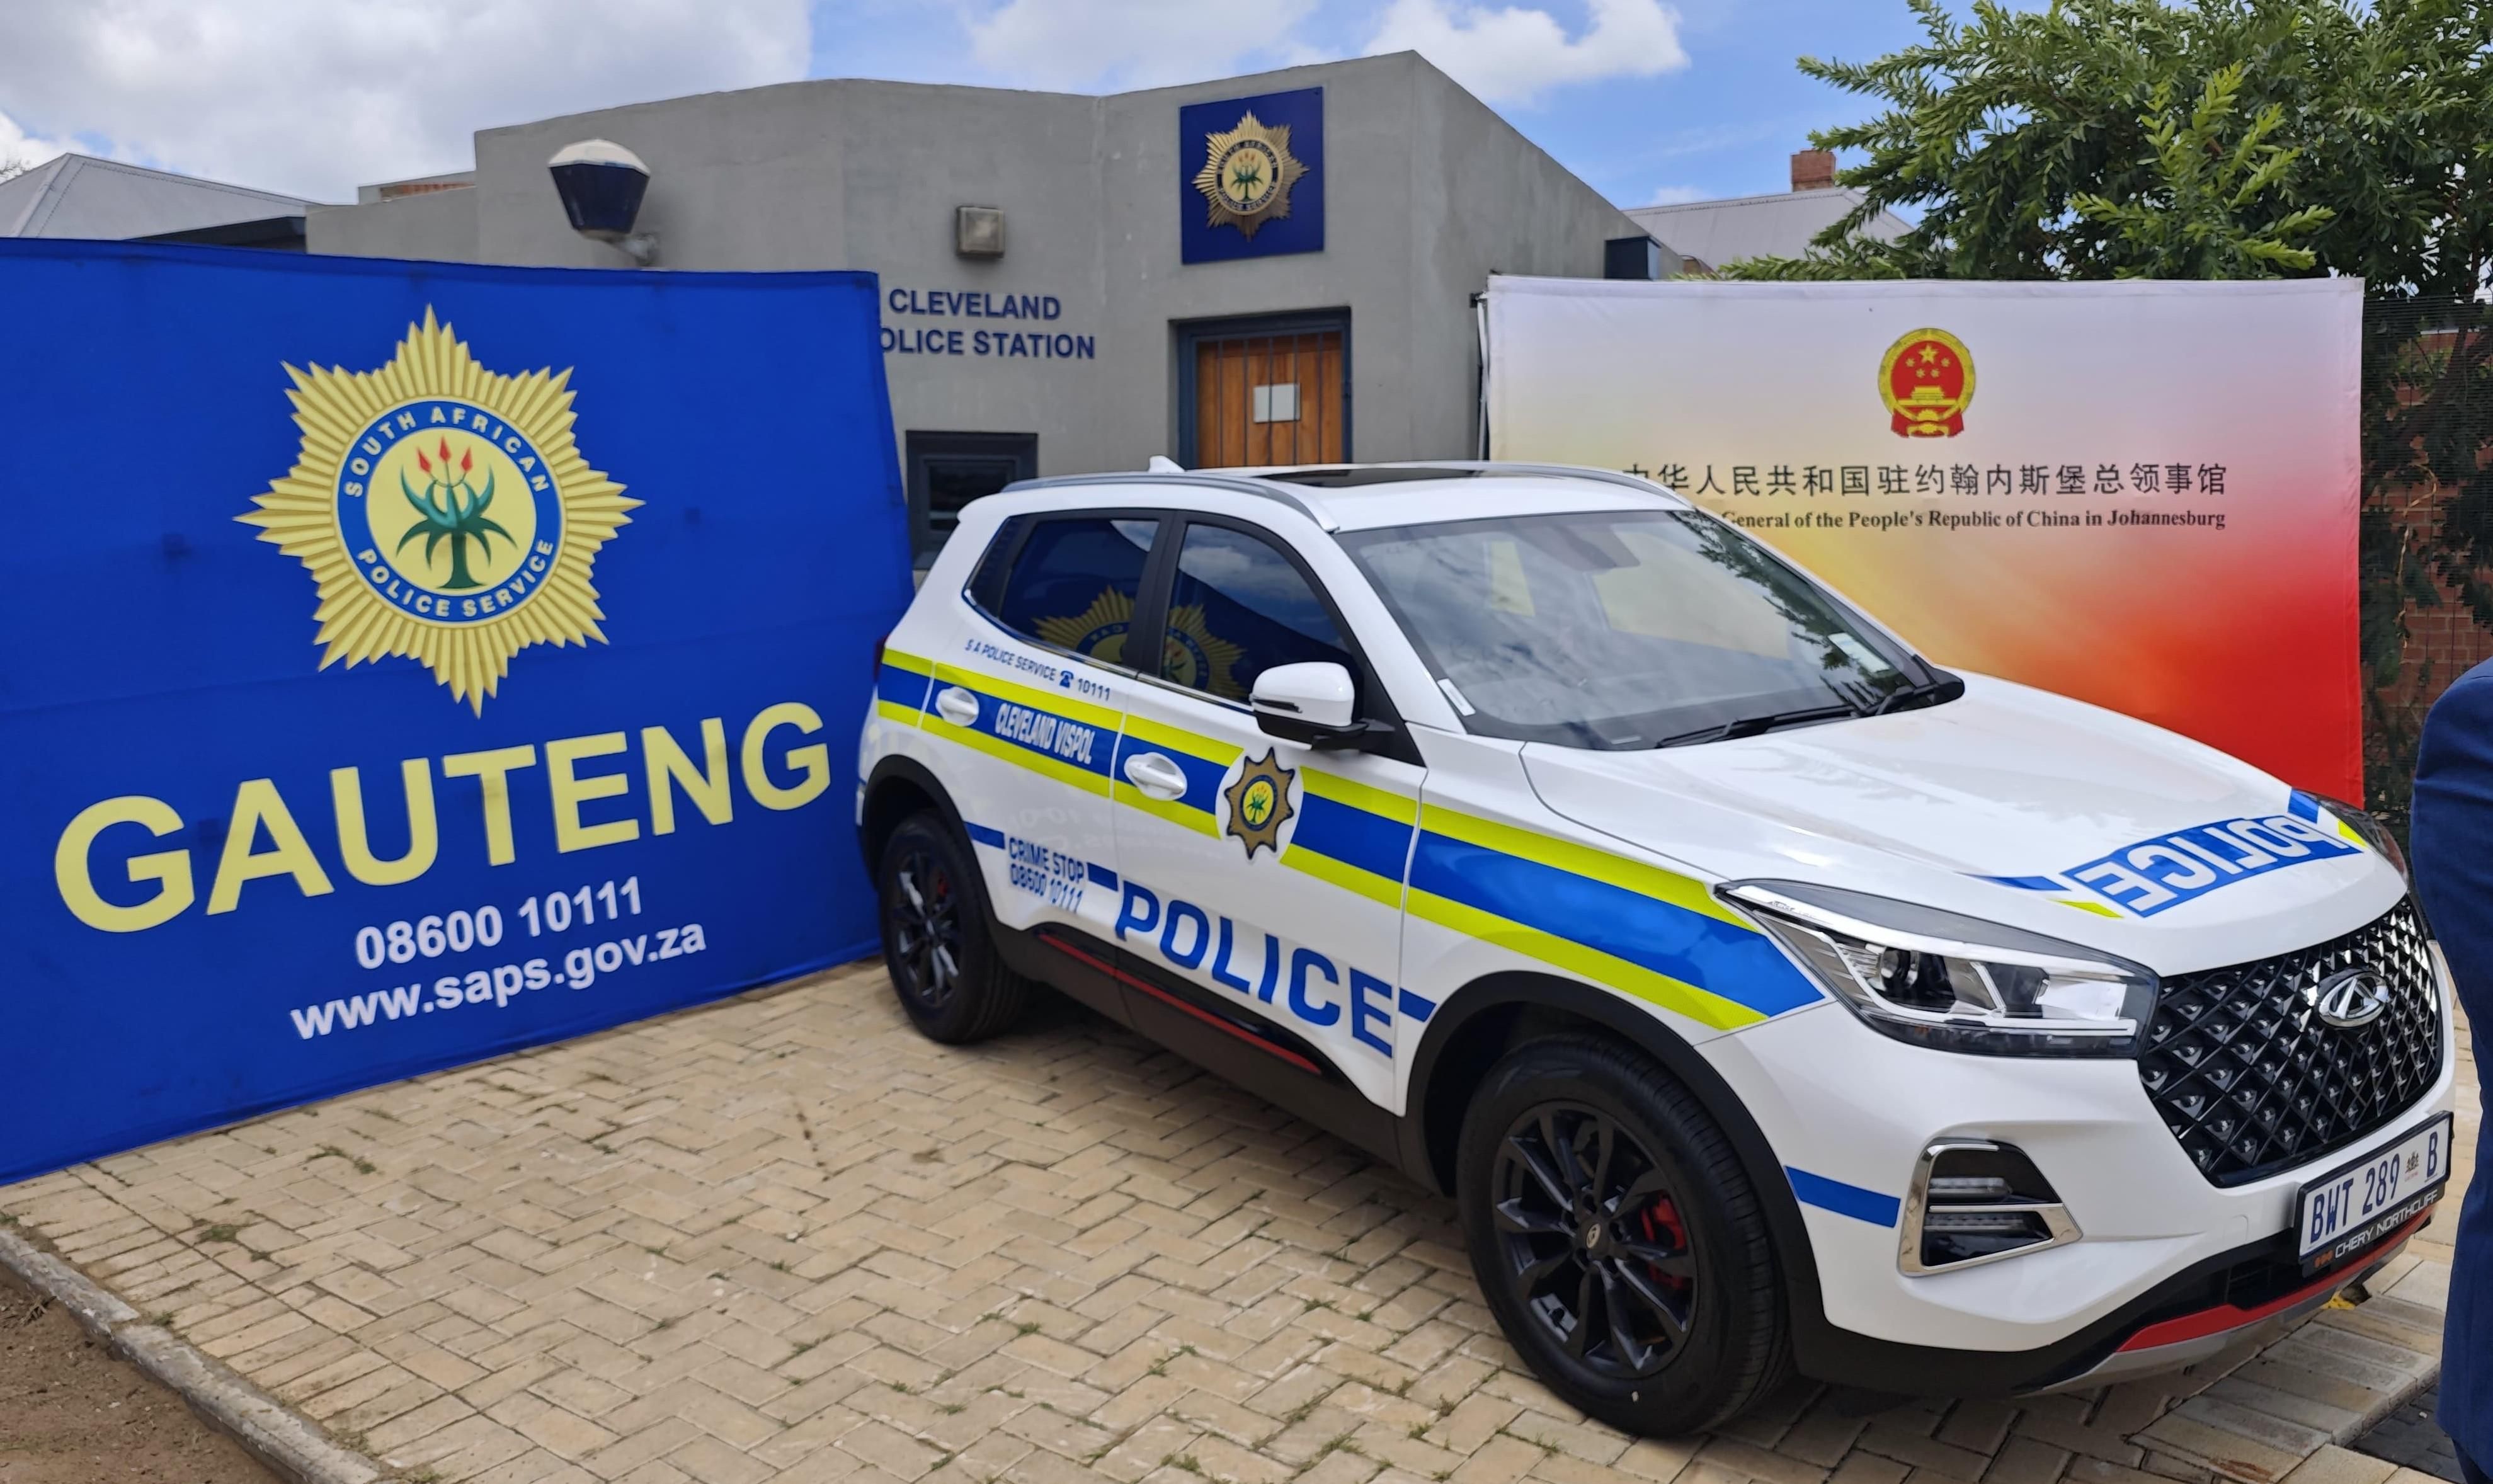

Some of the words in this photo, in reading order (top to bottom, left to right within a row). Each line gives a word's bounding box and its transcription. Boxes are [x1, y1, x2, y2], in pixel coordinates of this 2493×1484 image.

[889, 288, 1061, 321] CLEVELAND
[881, 327, 964, 355] OLICE
[973, 330, 1095, 359] STATION
[344, 409, 416, 499] SOUTH
[430, 406, 549, 492] AFRICAN
[1794, 511, 1812, 528] of
[1816, 511, 1843, 528] the
[1849, 510, 1923, 531] People's
[1929, 510, 2001, 531] Republic
[2005, 511, 2024, 527] of
[2026, 511, 2080, 527] China
[2085, 510, 2102, 527] in
[2107, 509, 2226, 531] Johannesburg
[357, 549, 450, 617] POLICE
[462, 540, 554, 617] SERVICE
[965, 639, 974, 651] S
[974, 641, 981, 653] A
[981, 644, 1015, 666] POLICE
[1015, 655, 1058, 682] SERVICE
[1078, 678, 1111, 702] 10111
[995, 702, 1058, 750] CLEVELAND
[1053, 720, 1096, 765] VISPOL
[55, 702, 830, 933] GAUTENG
[1009, 836, 1050, 871] CRIME
[1053, 852, 1085, 884] STOP
[356, 905, 503, 970] 08600
[518, 876, 641, 938] 10111
[290, 923, 706, 1040] www.saps.gov.za
[1114, 880, 1393, 1059] POLICE
[2310, 1177, 2354, 1244] BWT
[2362, 1153, 2400, 1216] 289
[2426, 1131, 2439, 1179] B
[2334, 1225, 2374, 1259] CHERY
[2376, 1189, 2438, 1236] NORTHCLIFF
